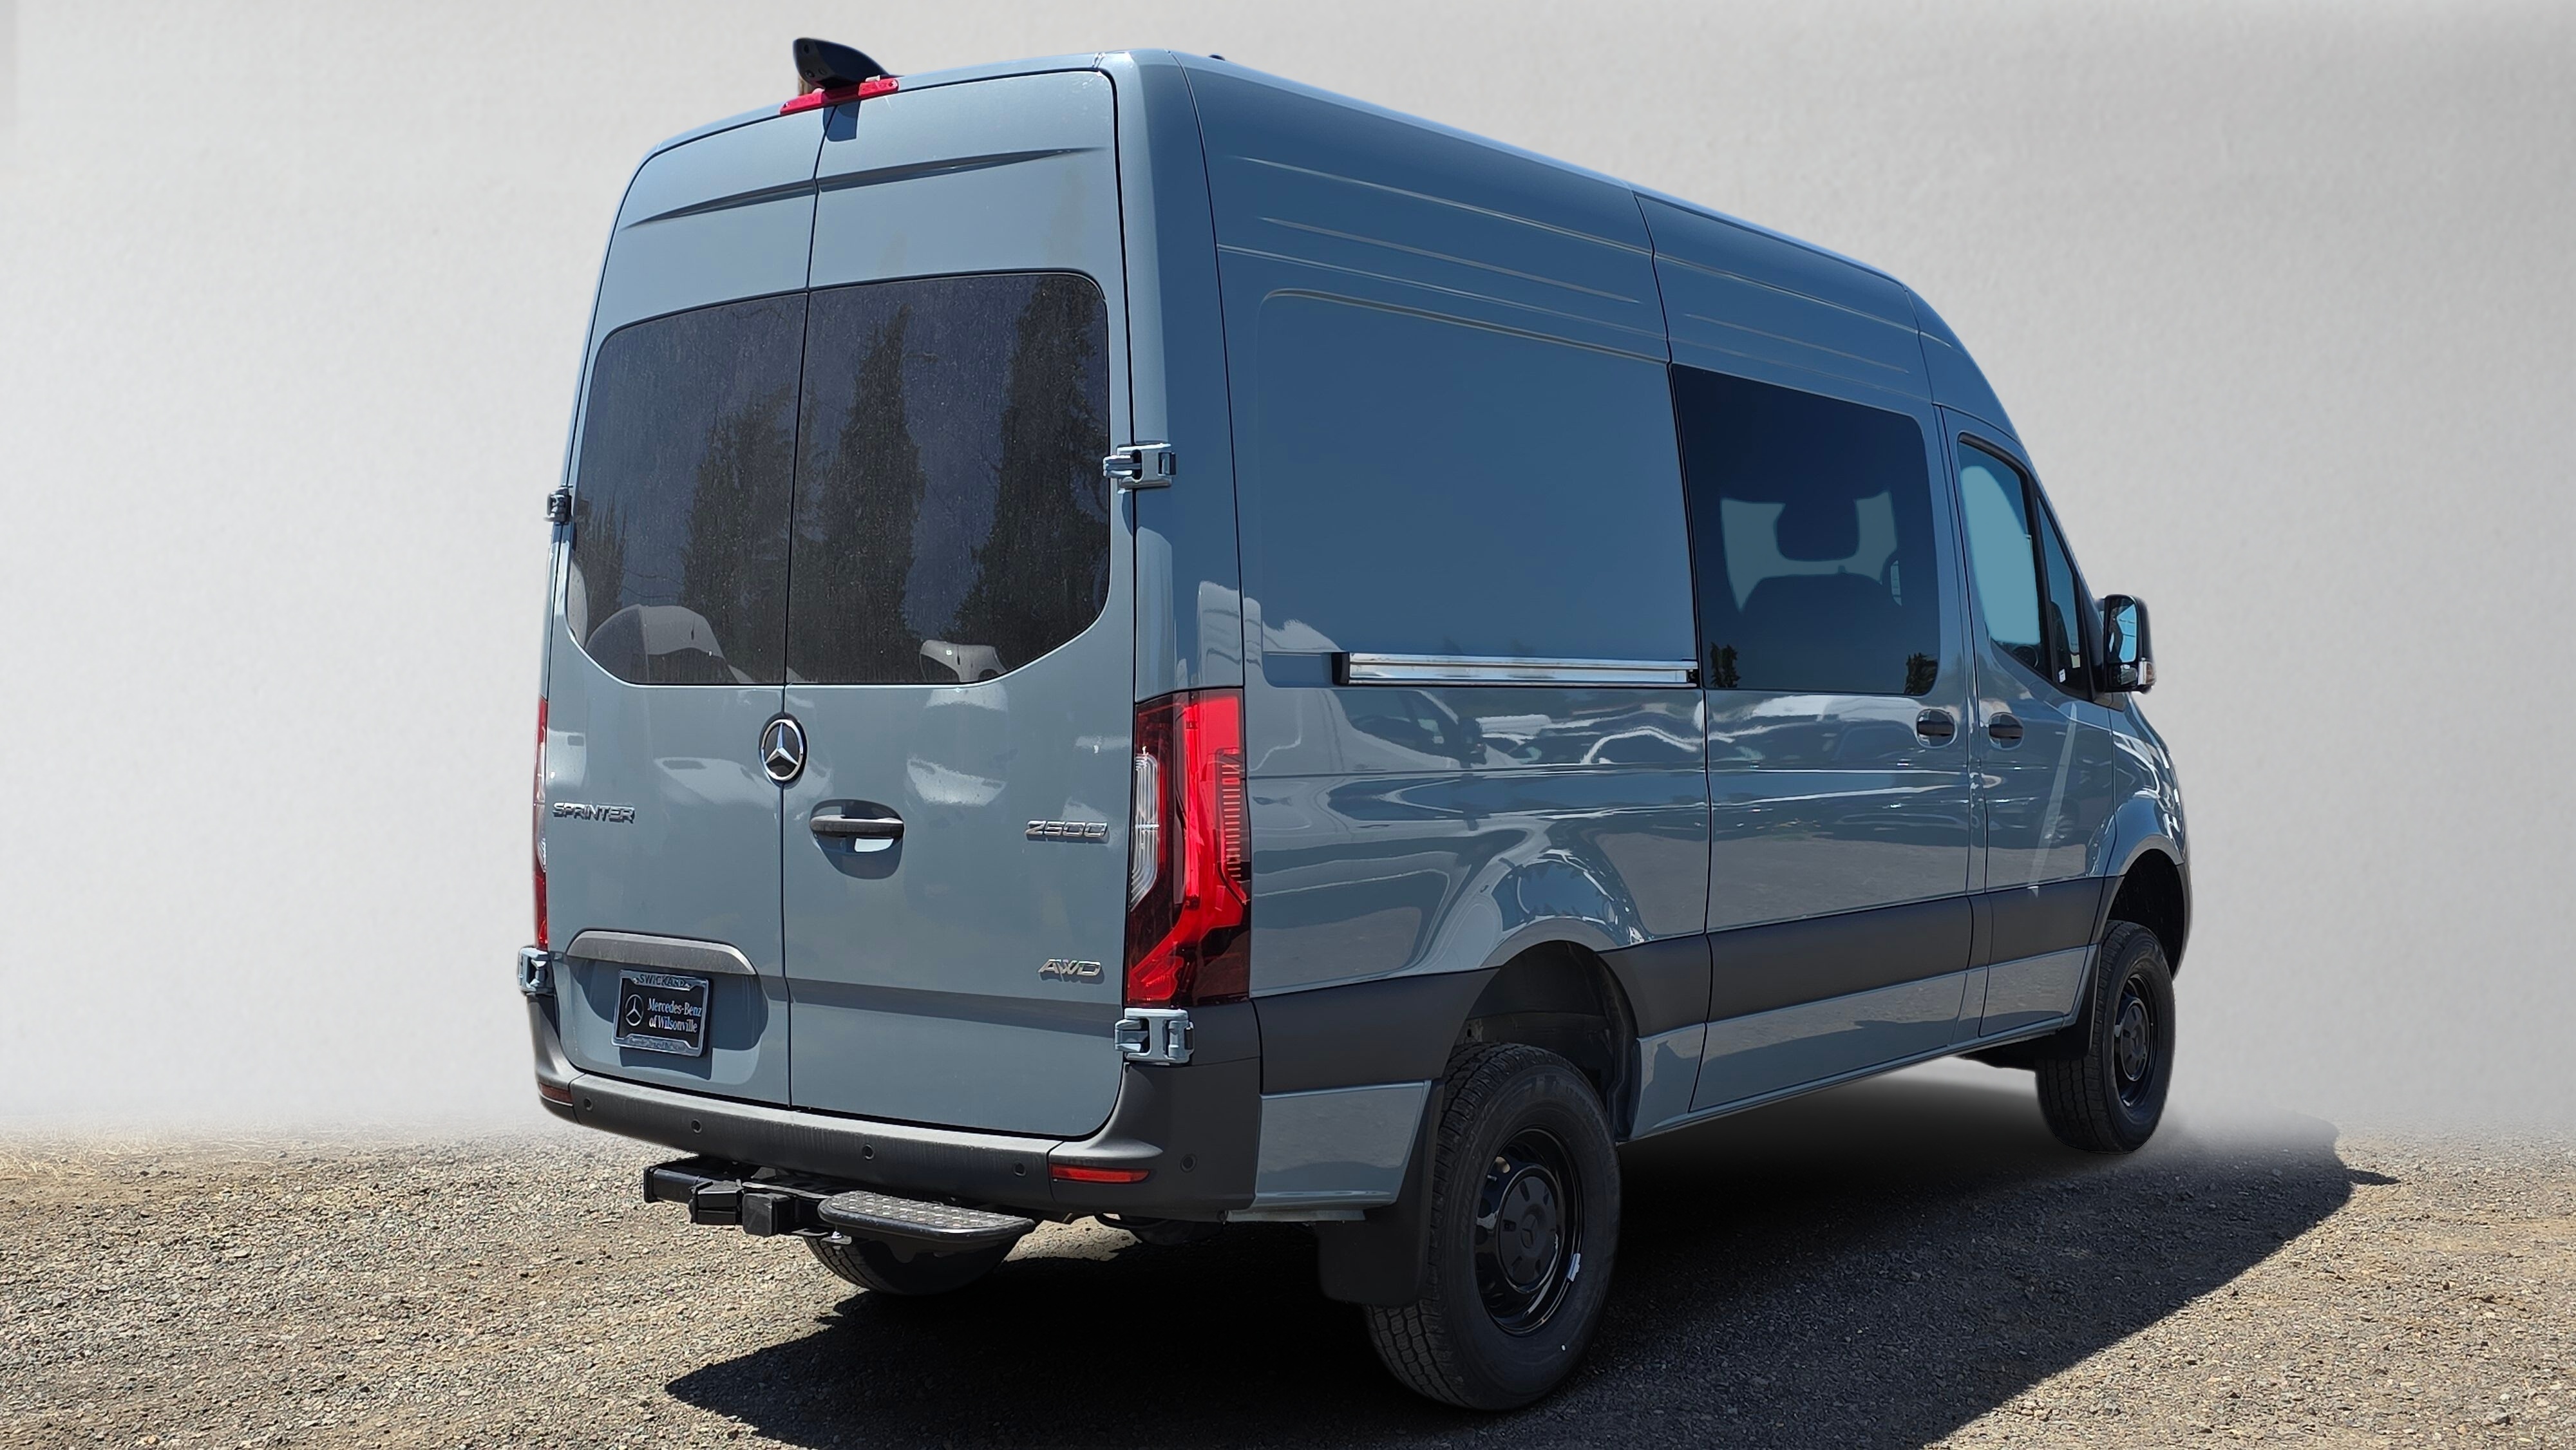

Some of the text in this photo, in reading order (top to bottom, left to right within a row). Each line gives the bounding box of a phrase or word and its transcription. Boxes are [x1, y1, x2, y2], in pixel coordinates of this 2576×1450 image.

[553, 802, 635, 824] SPRINTER
[1025, 820, 1108, 838] 2500
[1037, 958, 1101, 976] AWD
[639, 973, 685, 988] SWICKARD
[647, 998, 702, 1017] Mercedes-Benz
[649, 1015, 697, 1033] of Wilsonville
